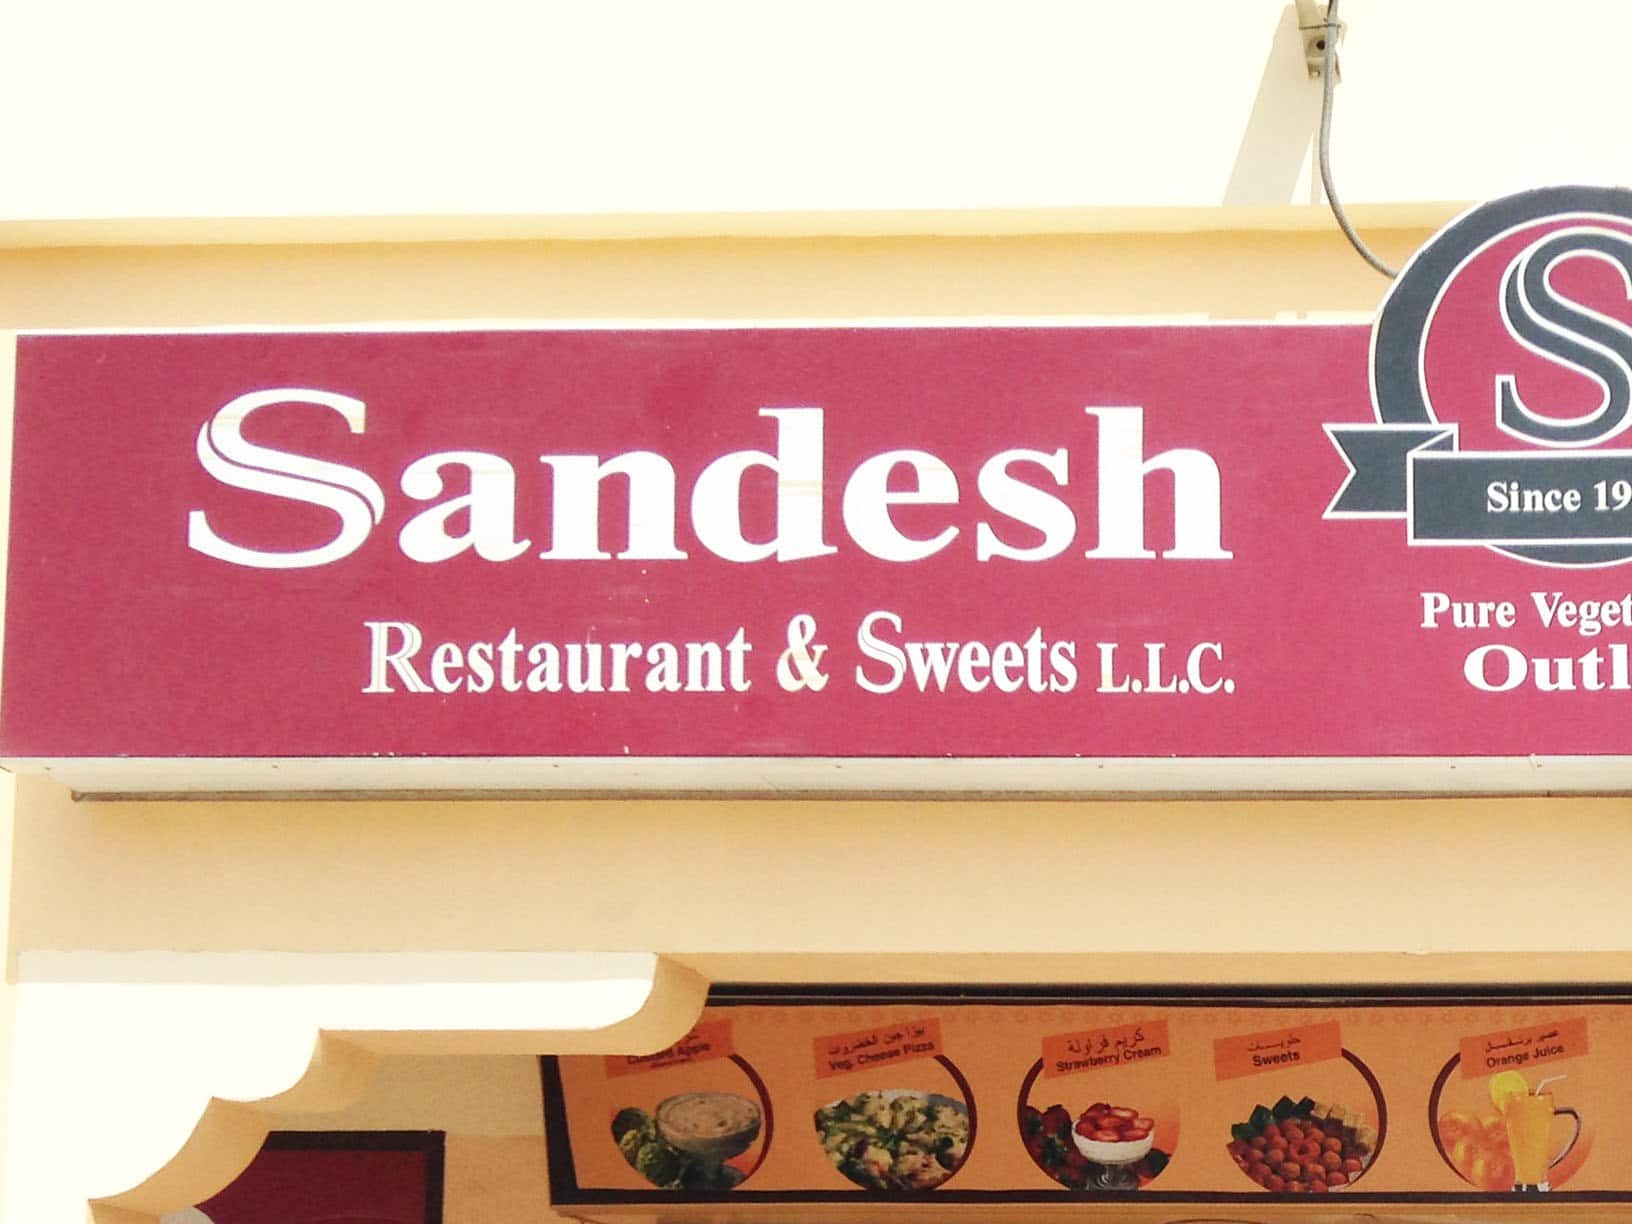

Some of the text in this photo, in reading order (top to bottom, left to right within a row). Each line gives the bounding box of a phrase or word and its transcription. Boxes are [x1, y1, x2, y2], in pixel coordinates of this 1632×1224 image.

[187, 388, 1234, 570] Sandesh
[1486, 480, 1581, 513] Since
[1420, 592, 1516, 629] Pure
[363, 610, 1235, 695] Restaurant & Sweets L.L.C.
[1055, 1045, 1162, 1073] Strawberry Cream
[1252, 1050, 1301, 1067] Sweets
[1486, 1043, 1565, 1069] Orange Juice
